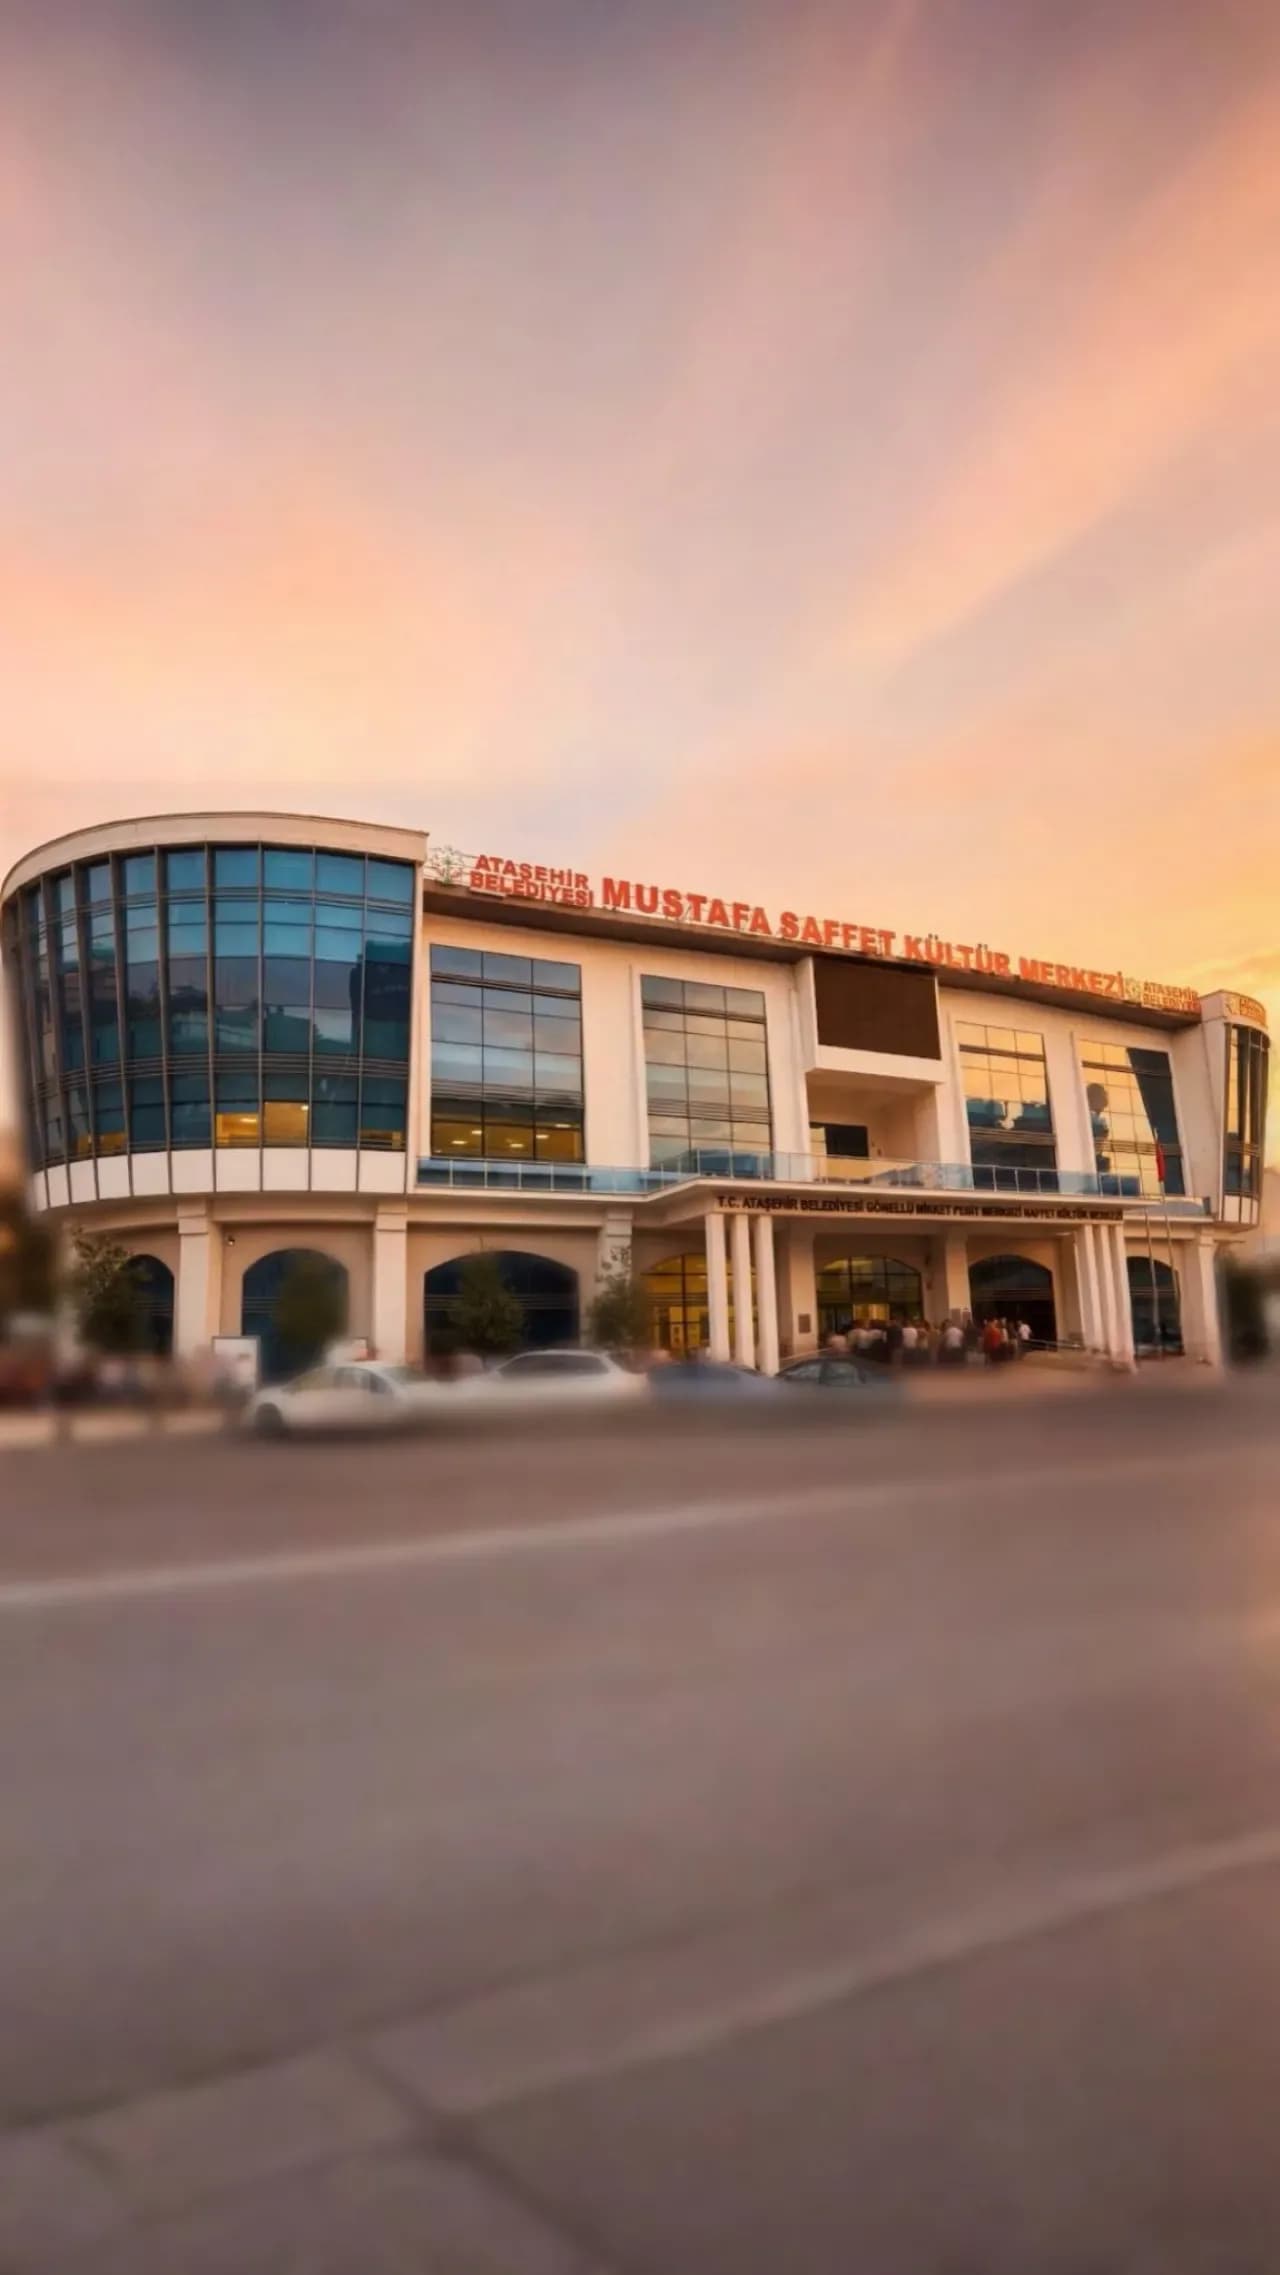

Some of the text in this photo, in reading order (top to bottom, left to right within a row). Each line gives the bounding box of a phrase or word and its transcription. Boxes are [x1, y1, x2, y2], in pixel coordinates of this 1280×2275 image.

[602, 877, 1125, 1000] MUSTAFA SAFFET KÜLTÜR MERKEZİ
[718, 1195, 740, 1209] T.C.
